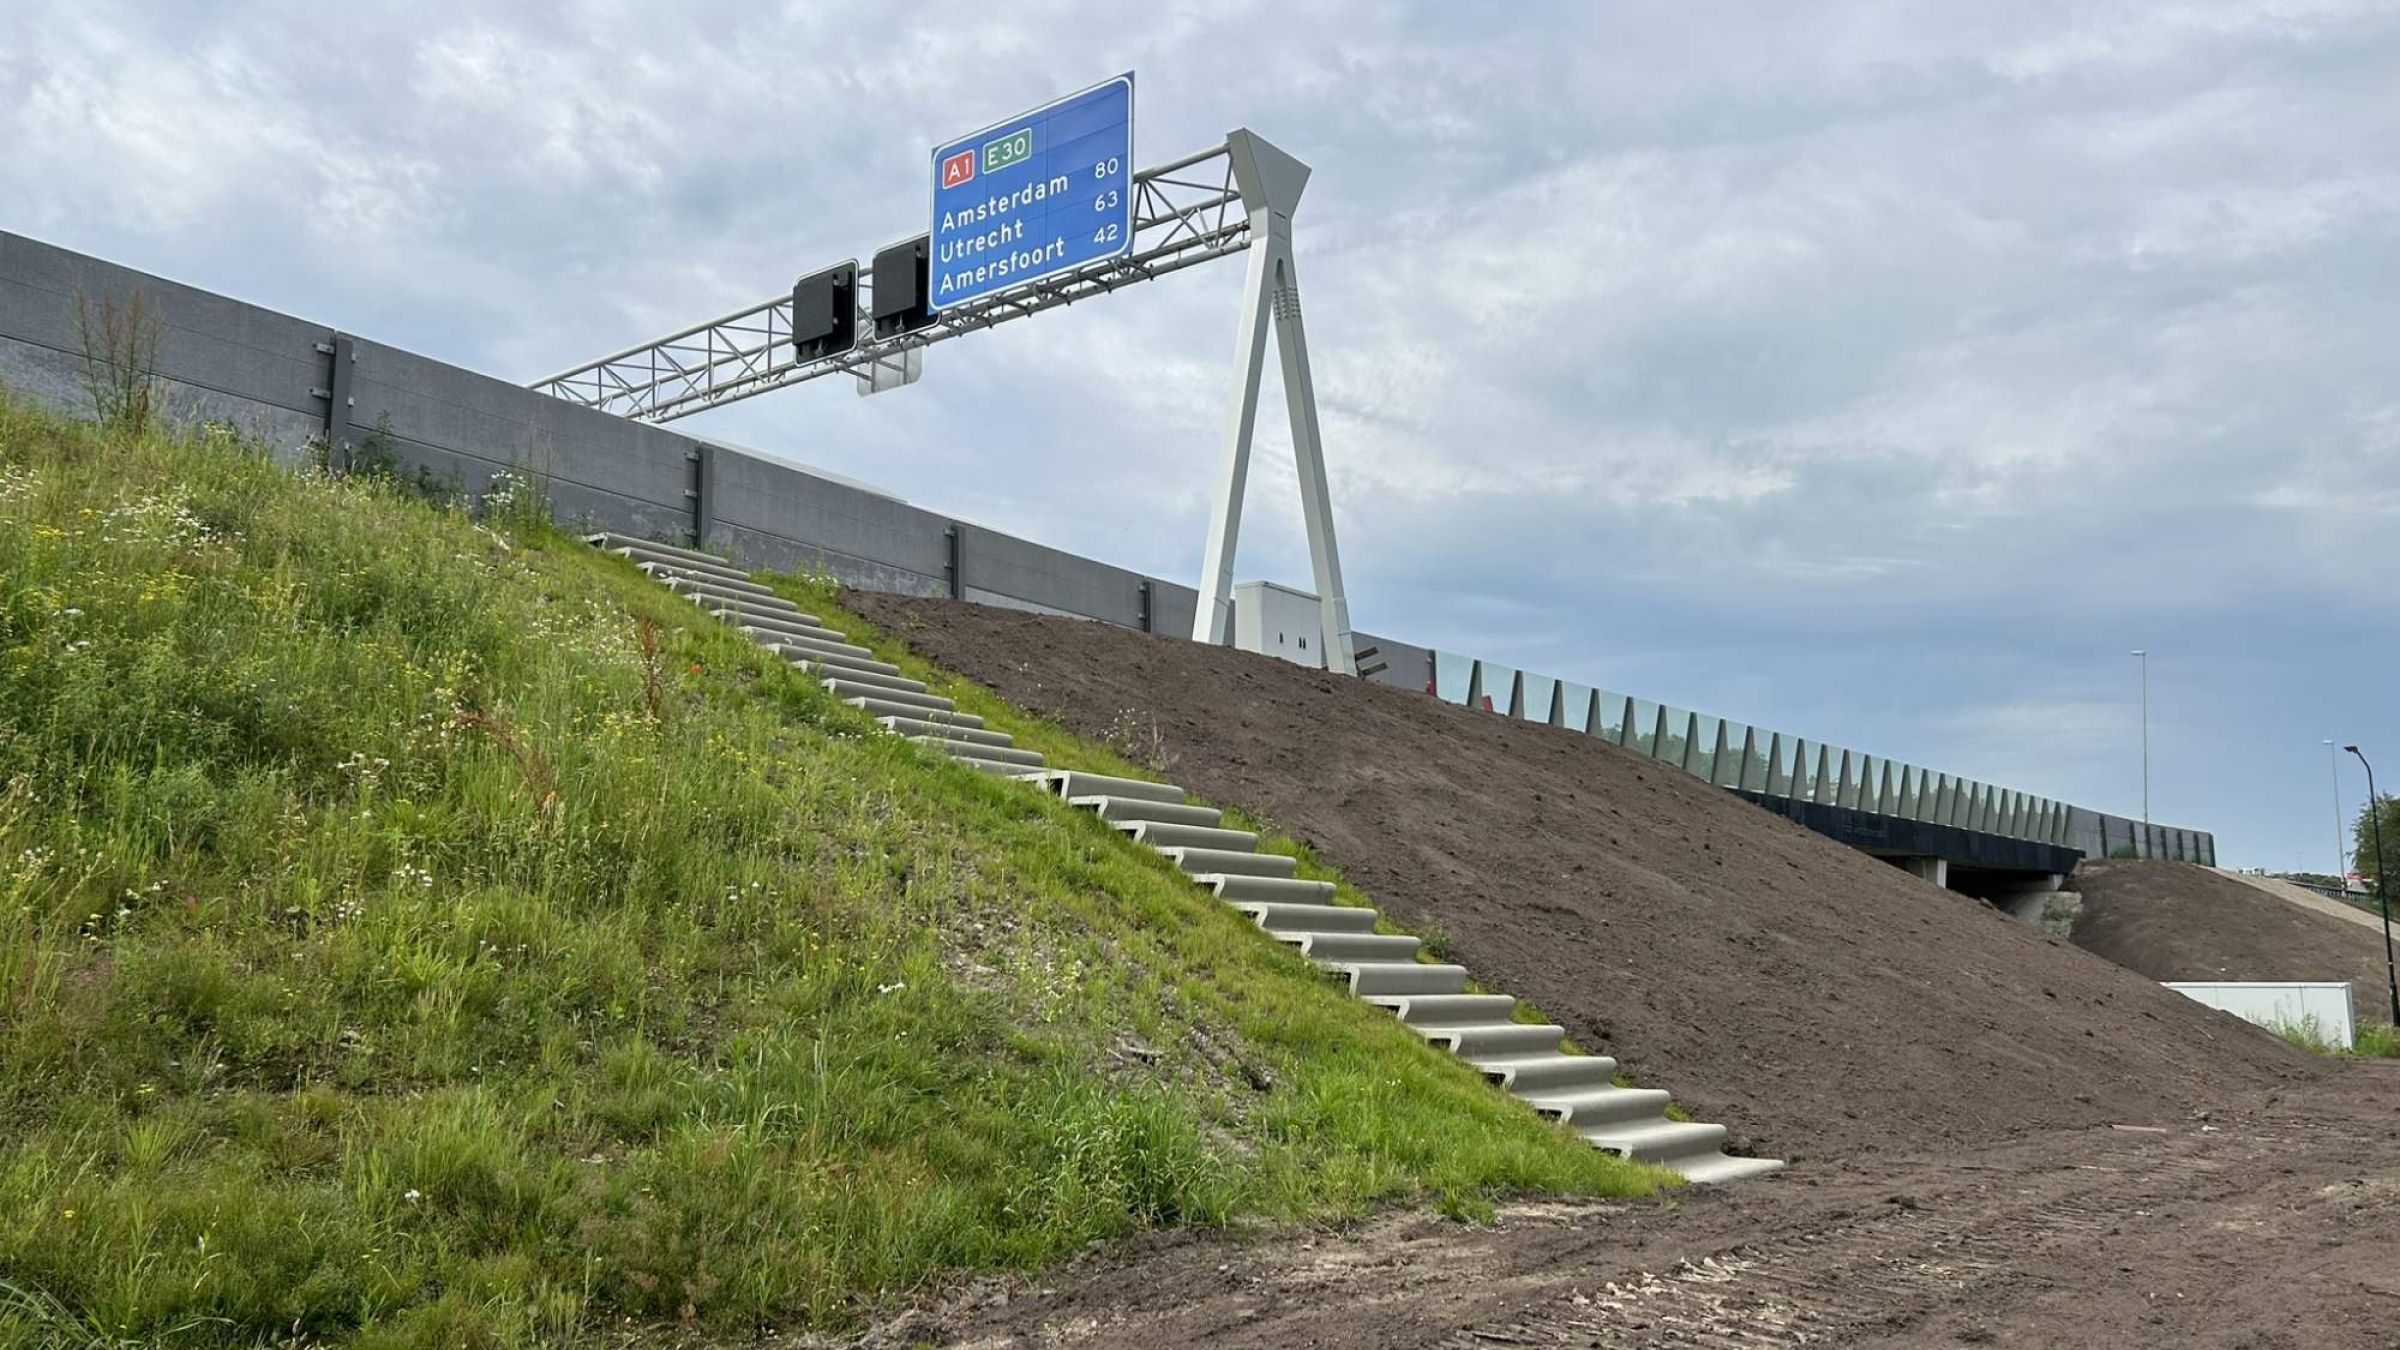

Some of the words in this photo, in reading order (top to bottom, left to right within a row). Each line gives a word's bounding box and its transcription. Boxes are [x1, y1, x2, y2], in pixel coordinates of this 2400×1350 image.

[948, 159, 970, 180] A1
[988, 138, 1026, 165] E30
[941, 176, 1068, 233] Amsterdam
[1095, 158, 1118, 178] 80
[941, 219, 1023, 262] Utrecht
[1095, 191, 1118, 212] 63
[939, 238, 1064, 294] Amersfoort
[1094, 224, 1118, 244] 42
